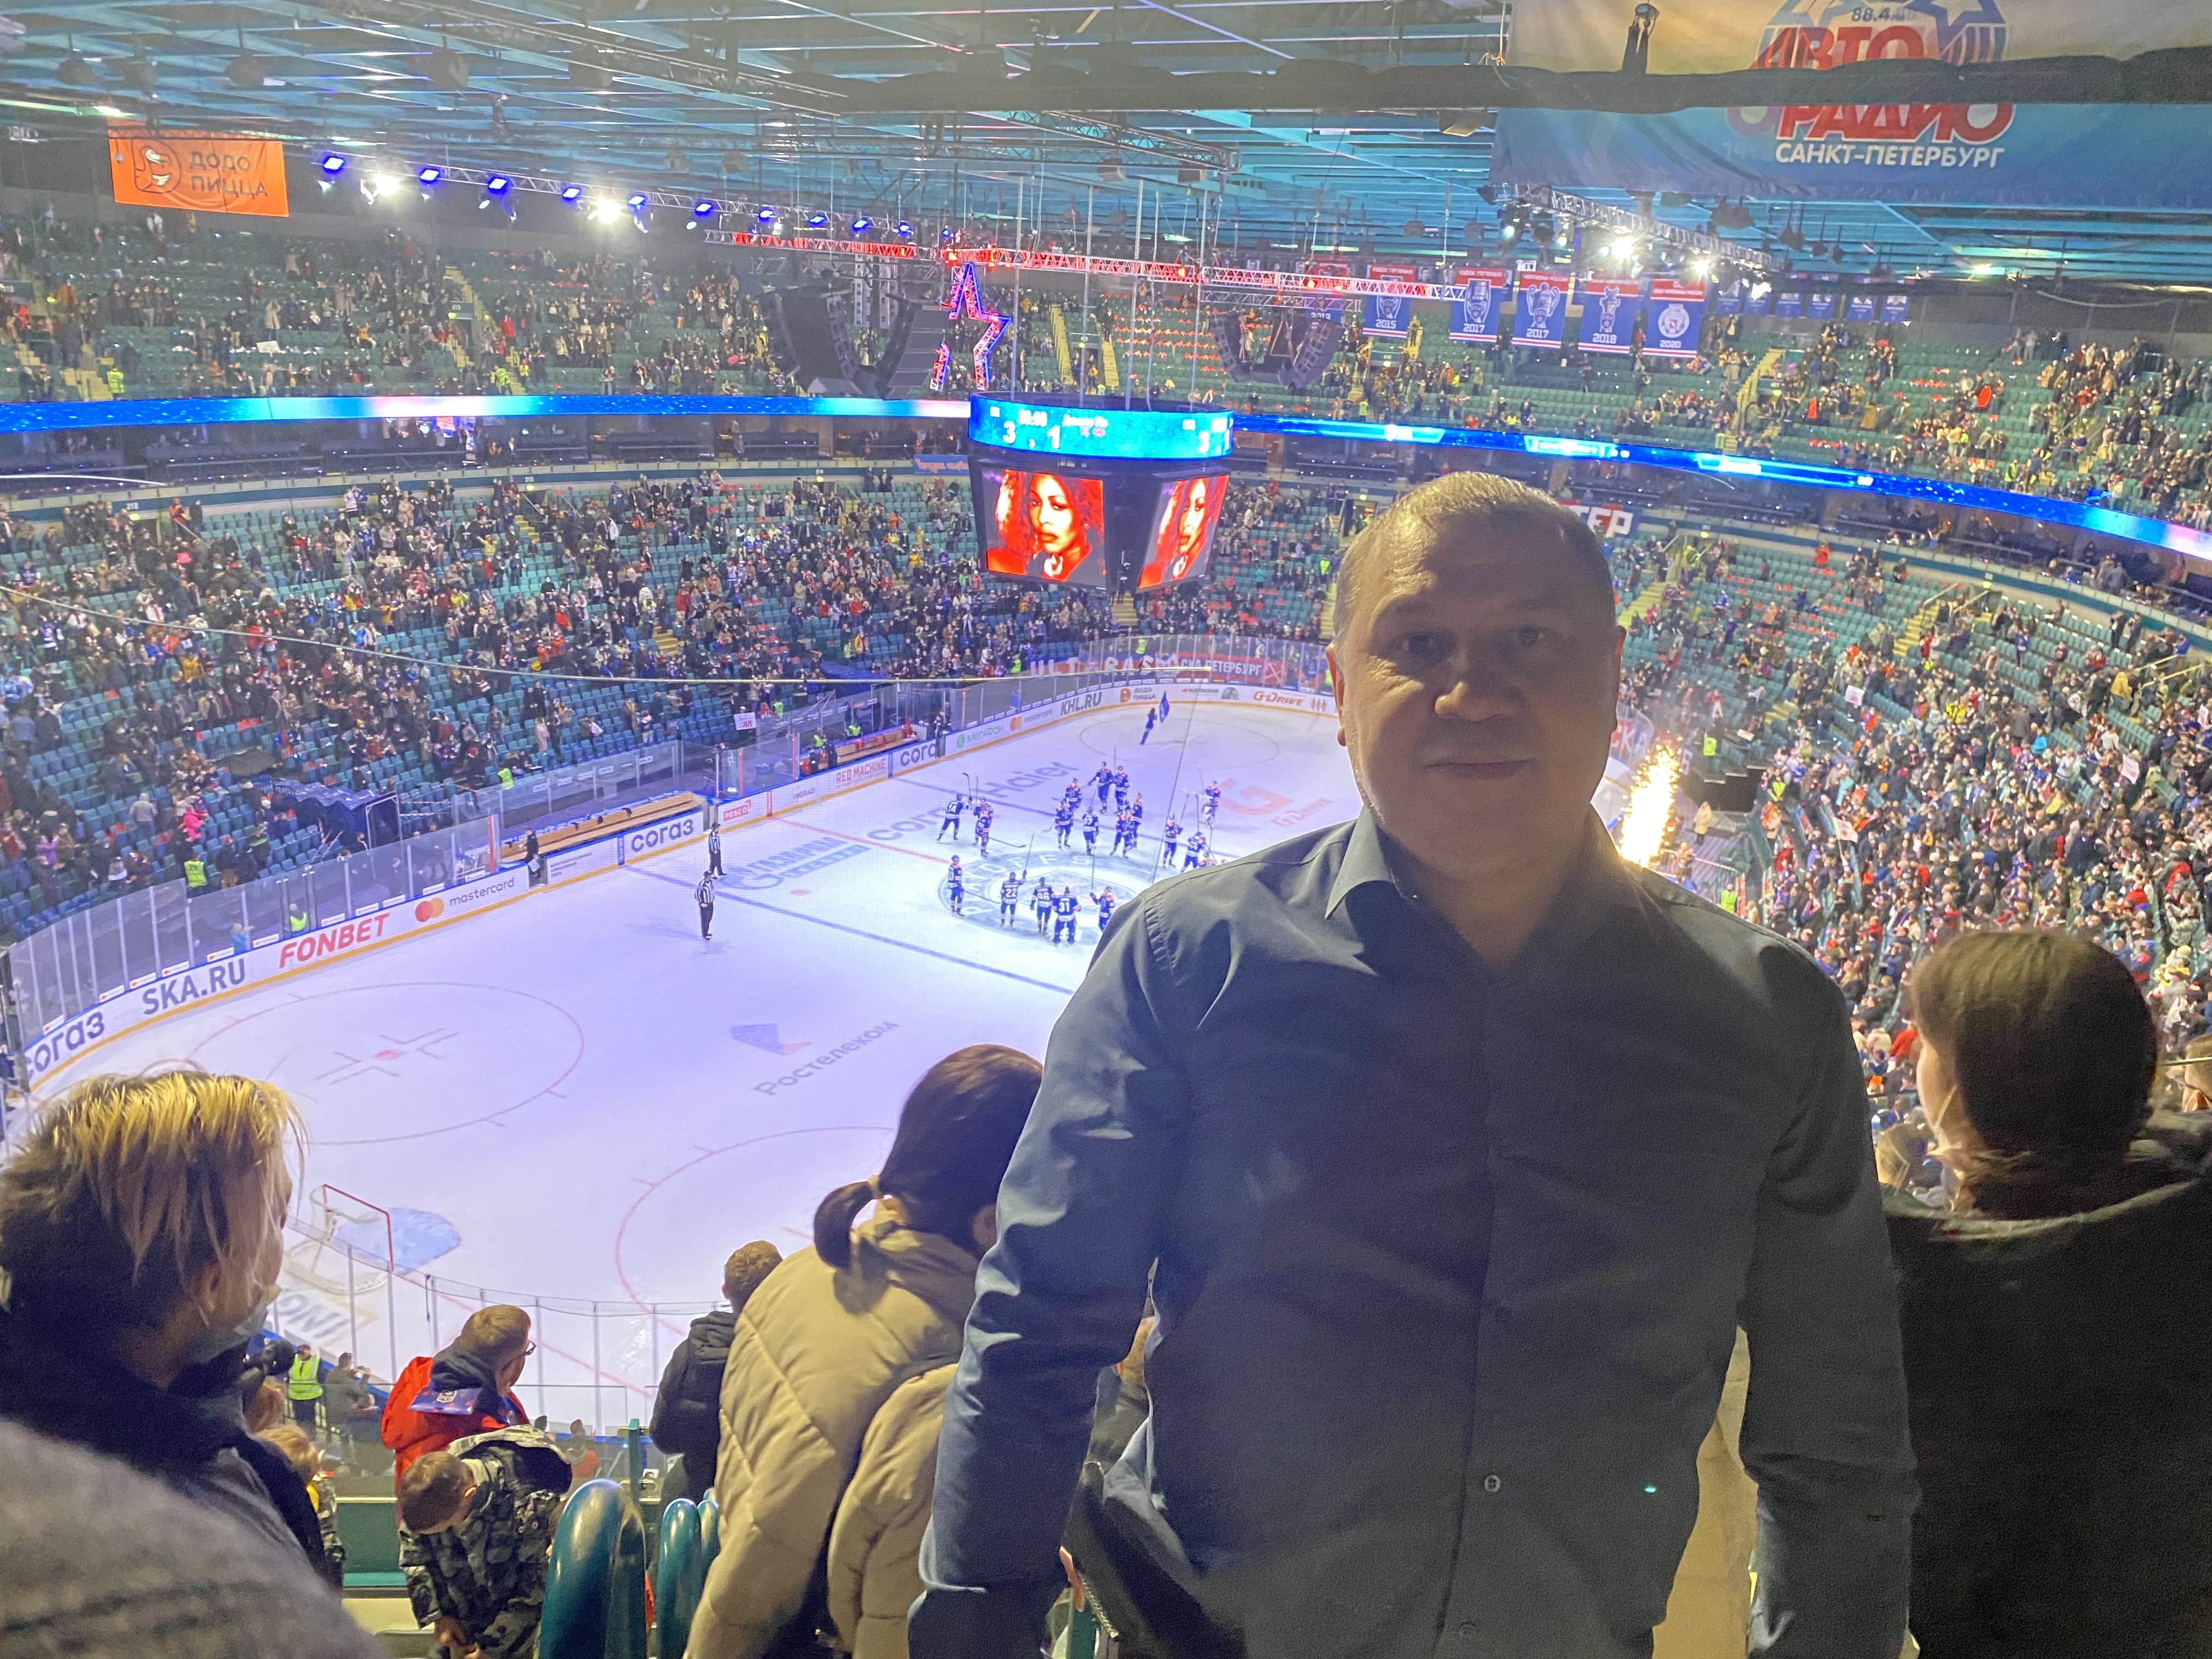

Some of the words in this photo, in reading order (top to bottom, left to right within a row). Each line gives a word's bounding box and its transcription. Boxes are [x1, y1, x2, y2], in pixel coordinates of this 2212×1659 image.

[189, 151, 250, 172] ДОДО
[1775, 143, 2006, 168] САНКТ-ПЕТЕРБУРГ
[191, 174, 267, 199] ПИЦЦА
[1375, 319, 1396, 329] 2015
[1463, 323, 1485, 333] 2017
[1526, 329, 1549, 338] 2017
[1593, 333, 1617, 344] 2018
[1660, 340, 1681, 349] 2020
[1003, 420, 1016, 444] 3
[1047, 425, 1060, 449] 1
[1060, 691, 1102, 716] KHL.RU
[967, 725, 1004, 743] МЕГАФОН
[900, 743, 936, 767] сога
[836, 769, 852, 785] RED
[853, 759, 886, 778] MACHINE
[793, 788, 815, 800] INGRAD
[449, 877, 515, 907] mastercard
[1005, 888, 1018, 898] 22
[1059, 902, 1070, 913] 31
[279, 912, 390, 969] FONBET
[142, 957, 246, 1015] SKA.RU
[753, 1021, 900, 1096] Ростелеком
